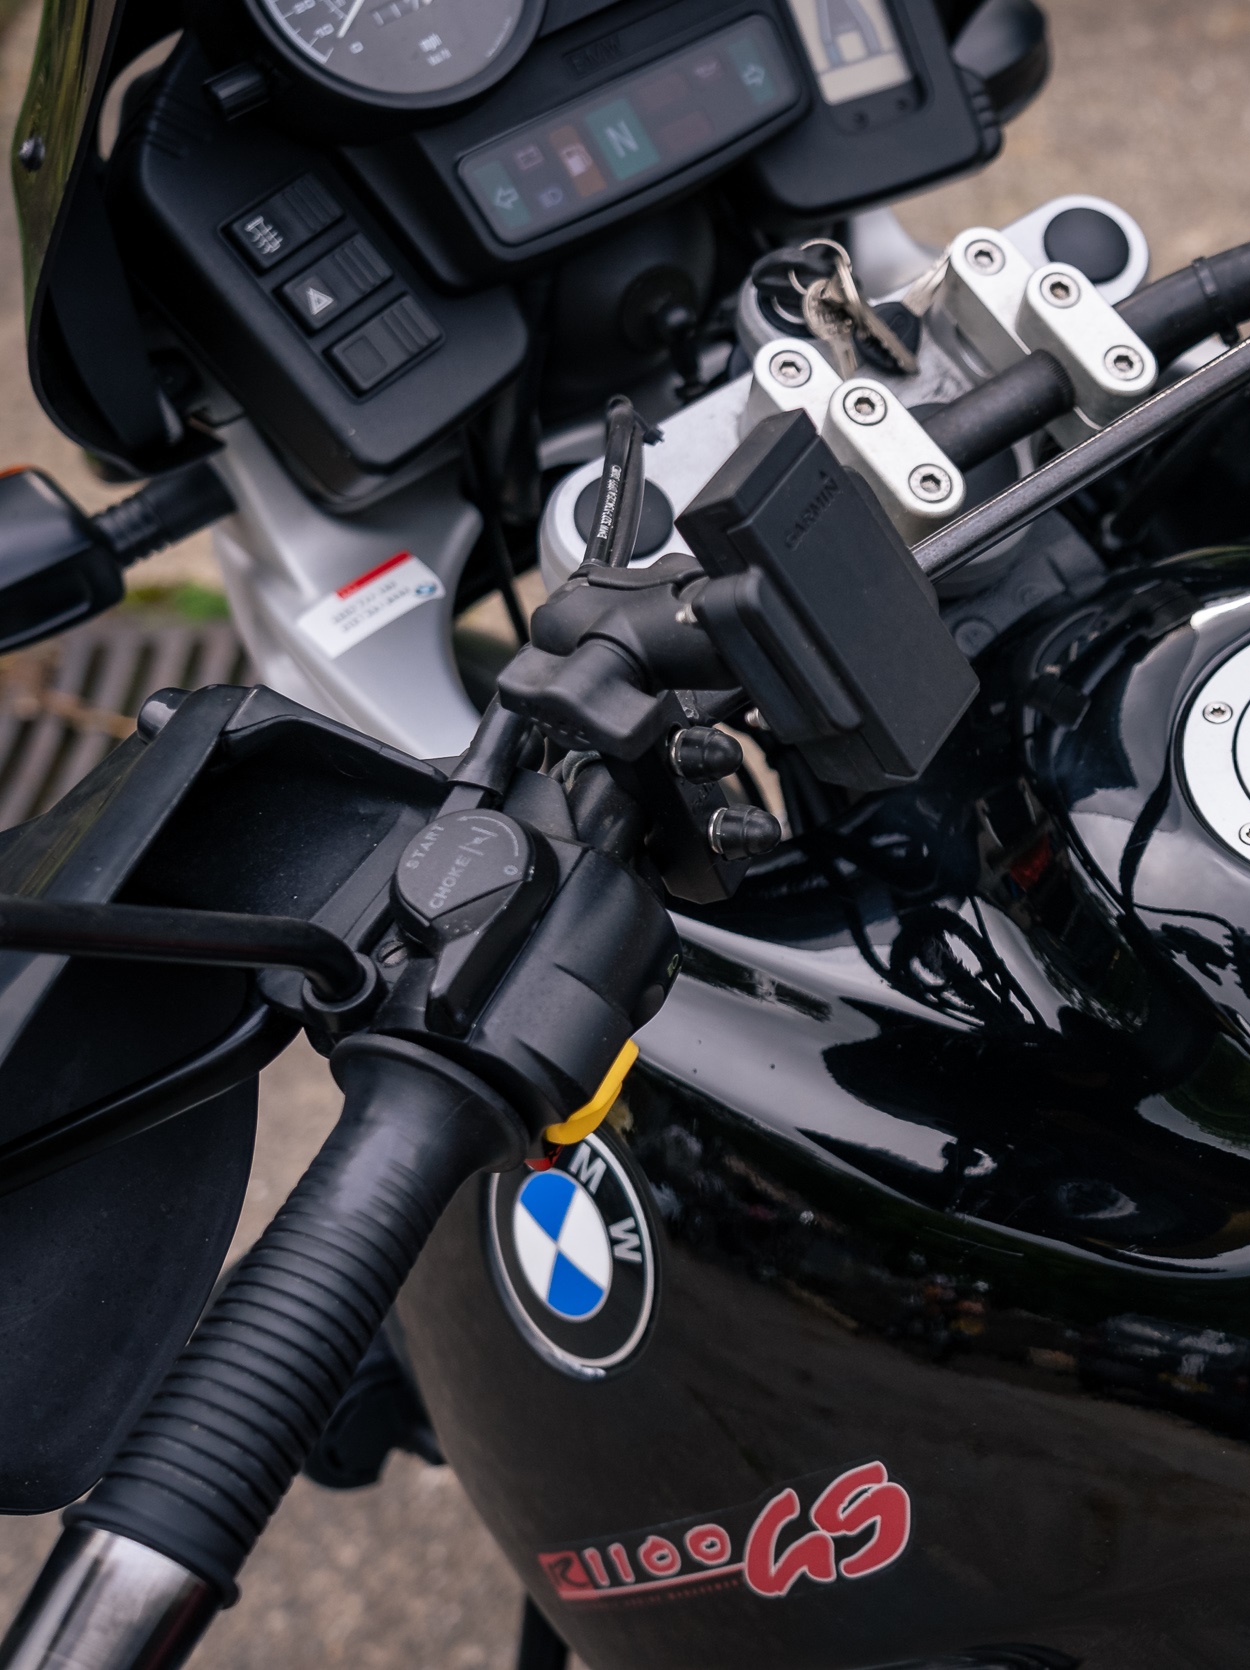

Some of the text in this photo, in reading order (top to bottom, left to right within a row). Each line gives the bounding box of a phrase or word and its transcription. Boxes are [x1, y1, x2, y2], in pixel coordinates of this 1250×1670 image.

[605, 120, 639, 159] N
[783, 476, 839, 551] GARMIN
[406, 823, 445, 869] START
[429, 854, 471, 909] CHOKE
[568, 1141, 643, 1264] MW
[548, 1460, 911, 1597] R1100 GS
